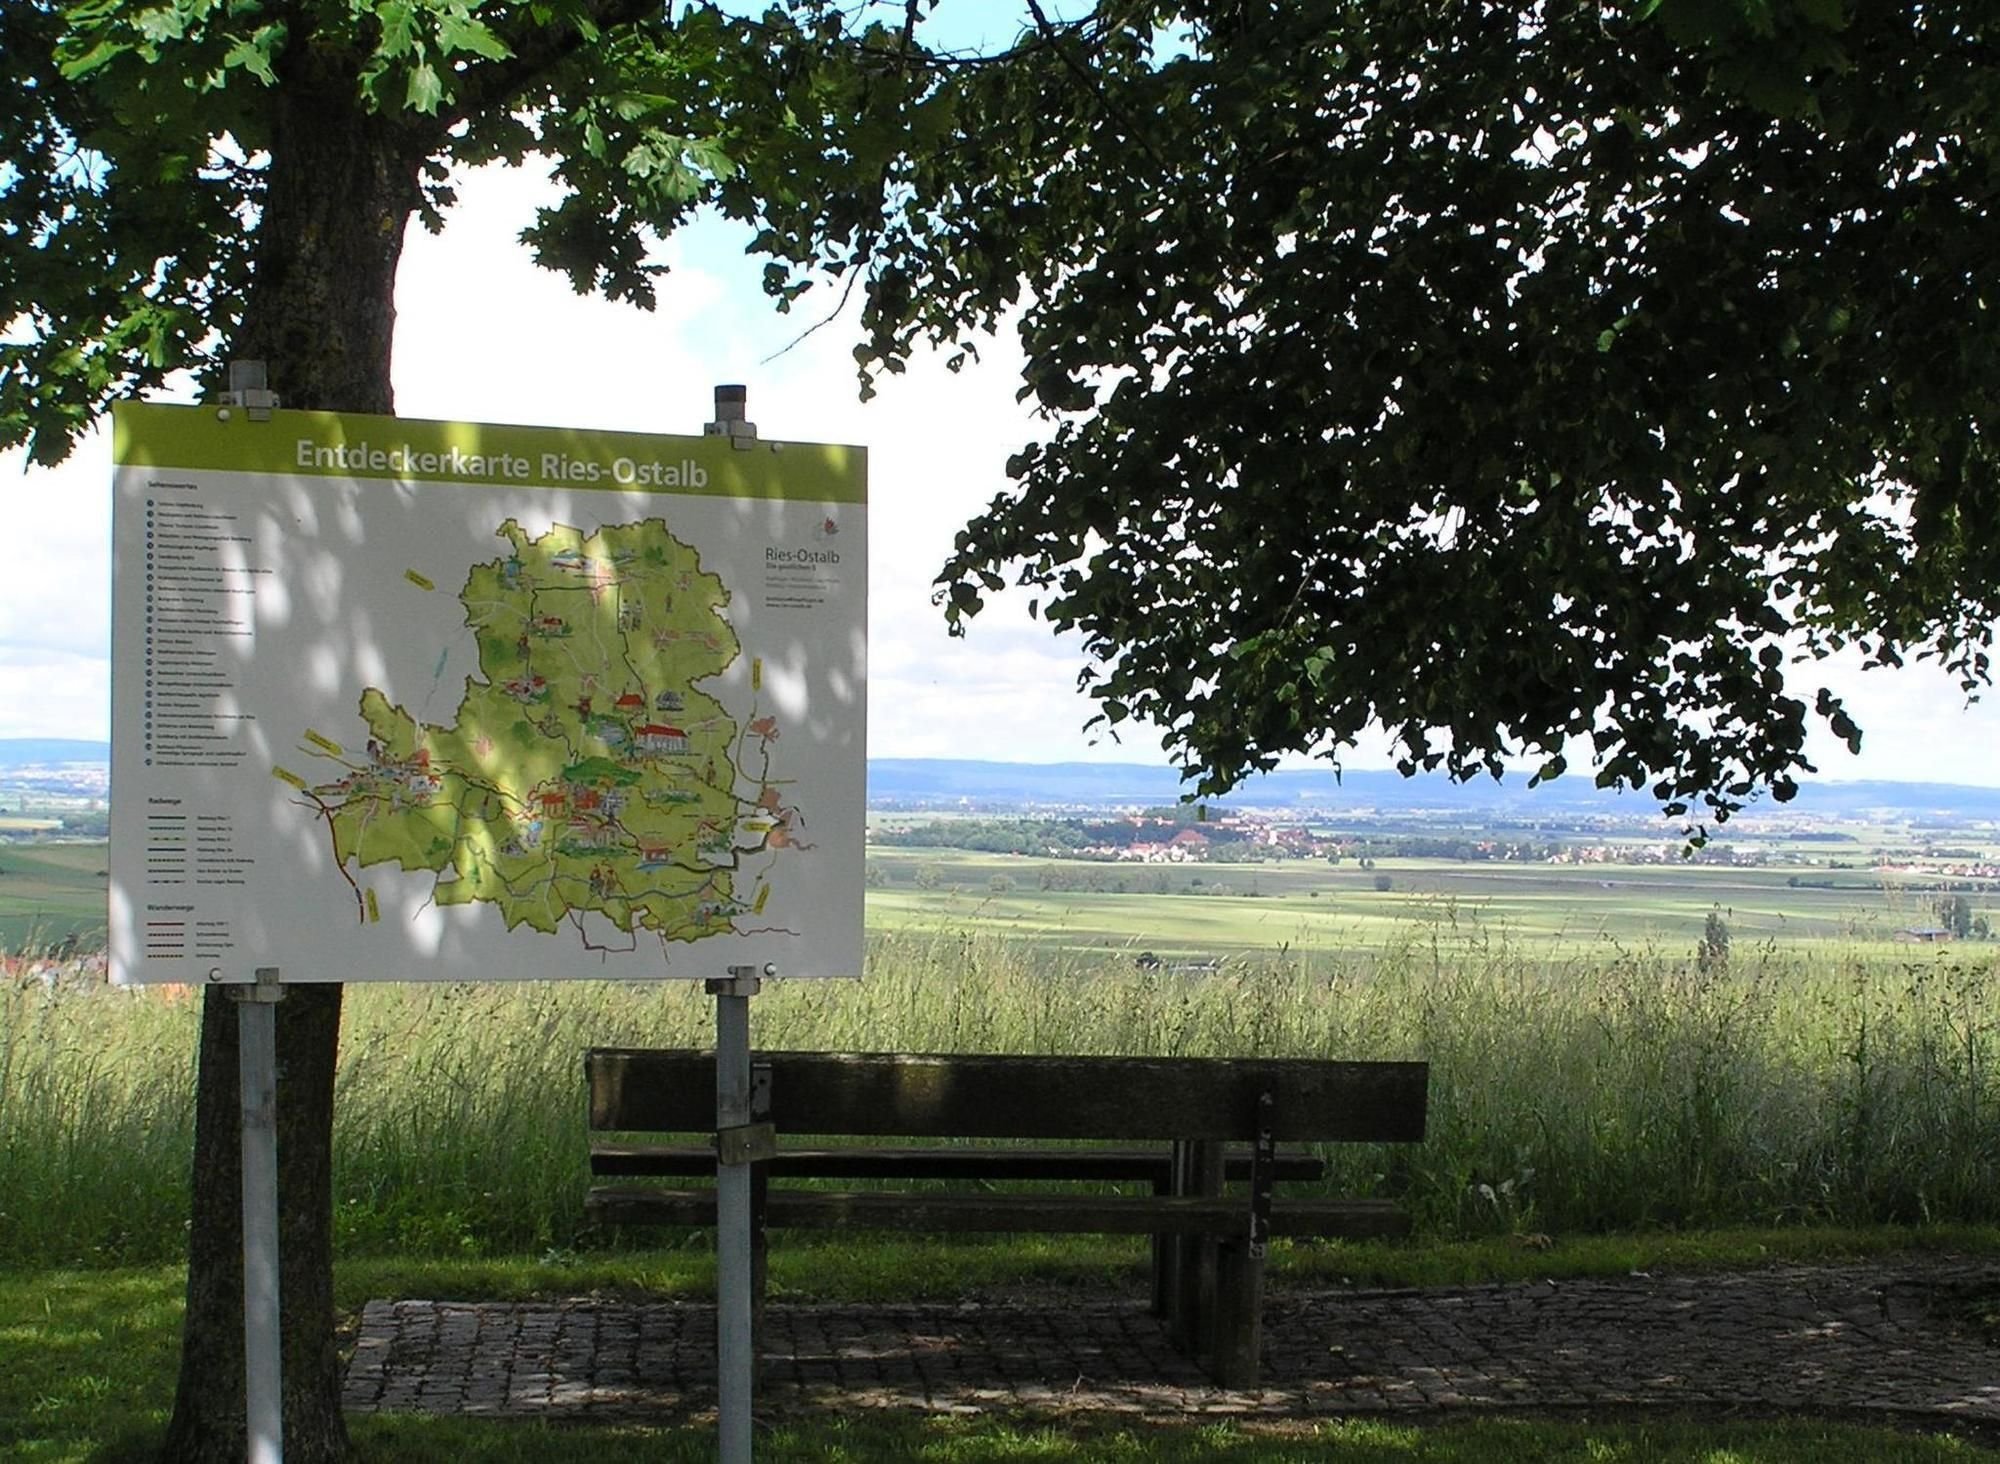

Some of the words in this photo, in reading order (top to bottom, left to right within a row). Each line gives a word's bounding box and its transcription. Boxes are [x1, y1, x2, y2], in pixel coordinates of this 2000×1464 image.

[296, 439, 530, 479] Entdeckerkarte
[541, 453, 708, 489] Ries-Ostalb
[766, 547, 840, 563] Ries-Ostalb
